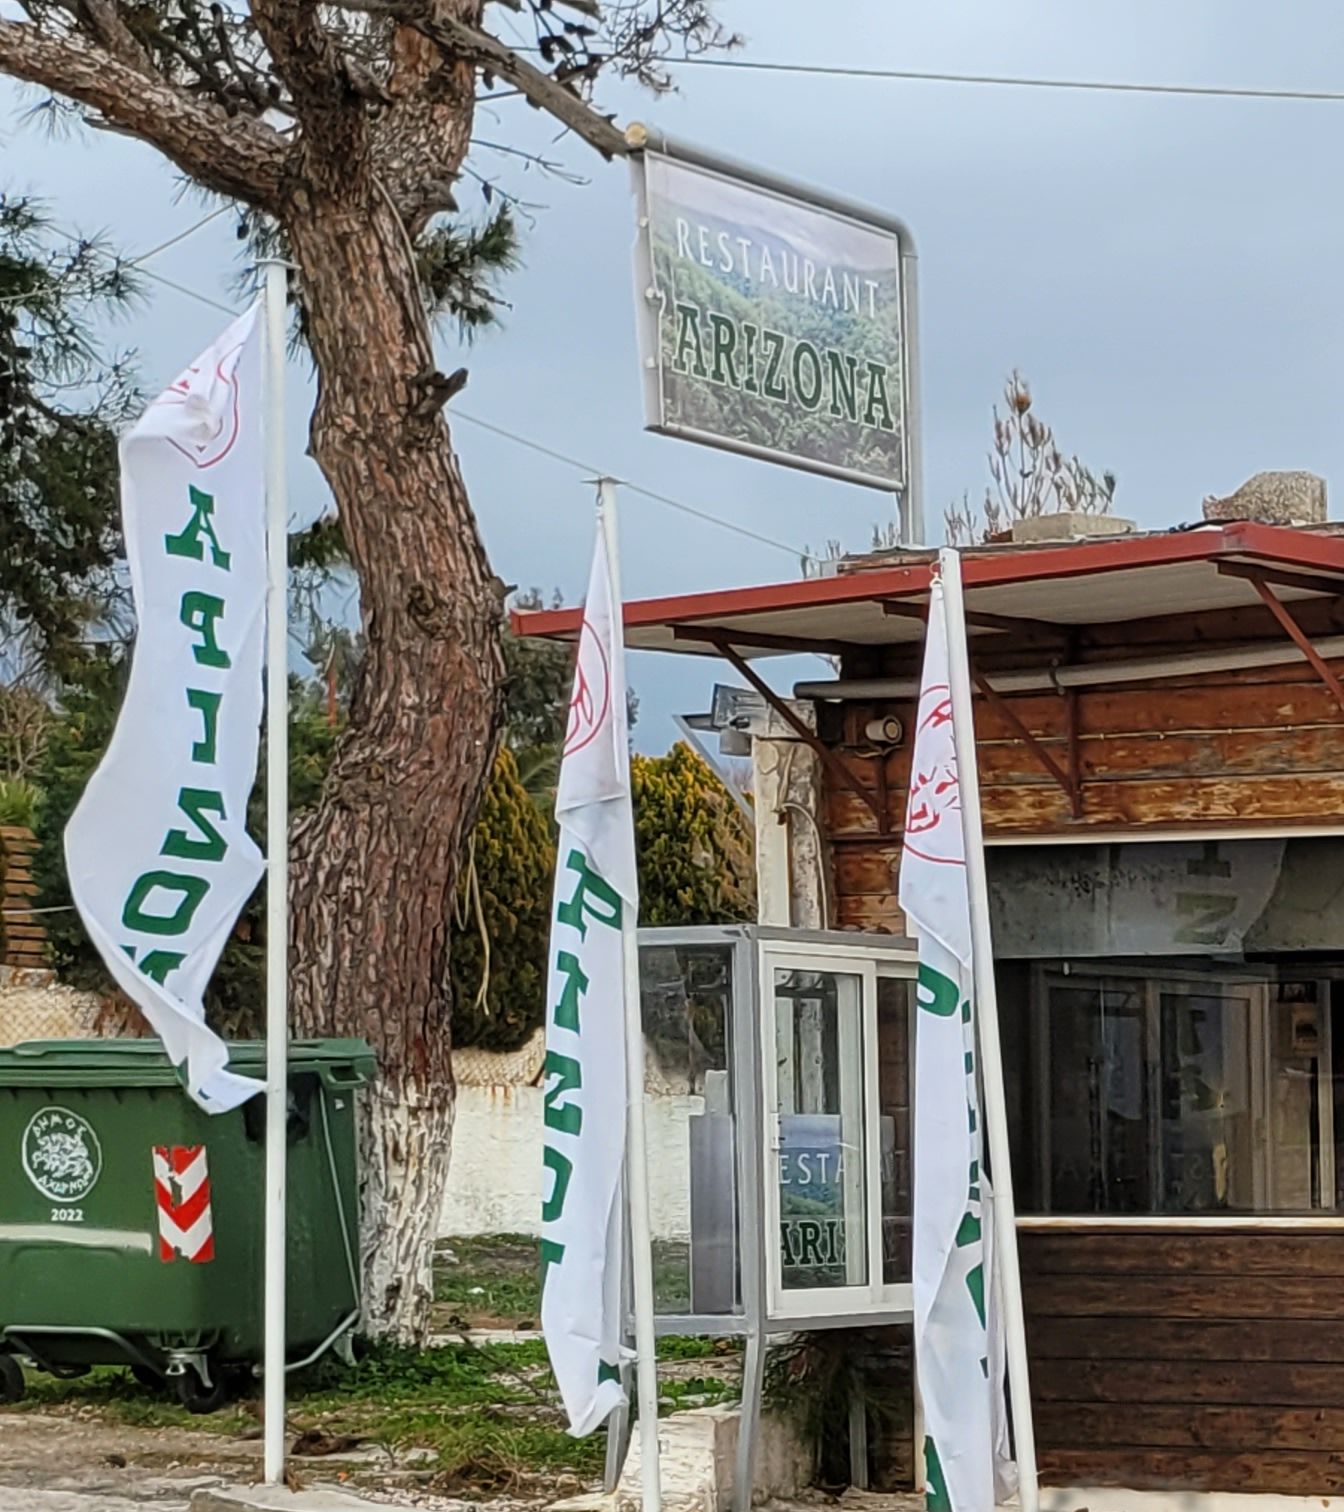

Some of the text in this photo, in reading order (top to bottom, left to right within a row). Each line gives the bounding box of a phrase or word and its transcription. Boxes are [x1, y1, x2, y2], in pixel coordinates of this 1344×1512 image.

[675, 217, 880, 319] RESTAURANT
[671, 302, 896, 432] ARIZONA
[50, 1208, 84, 1221] 2022
